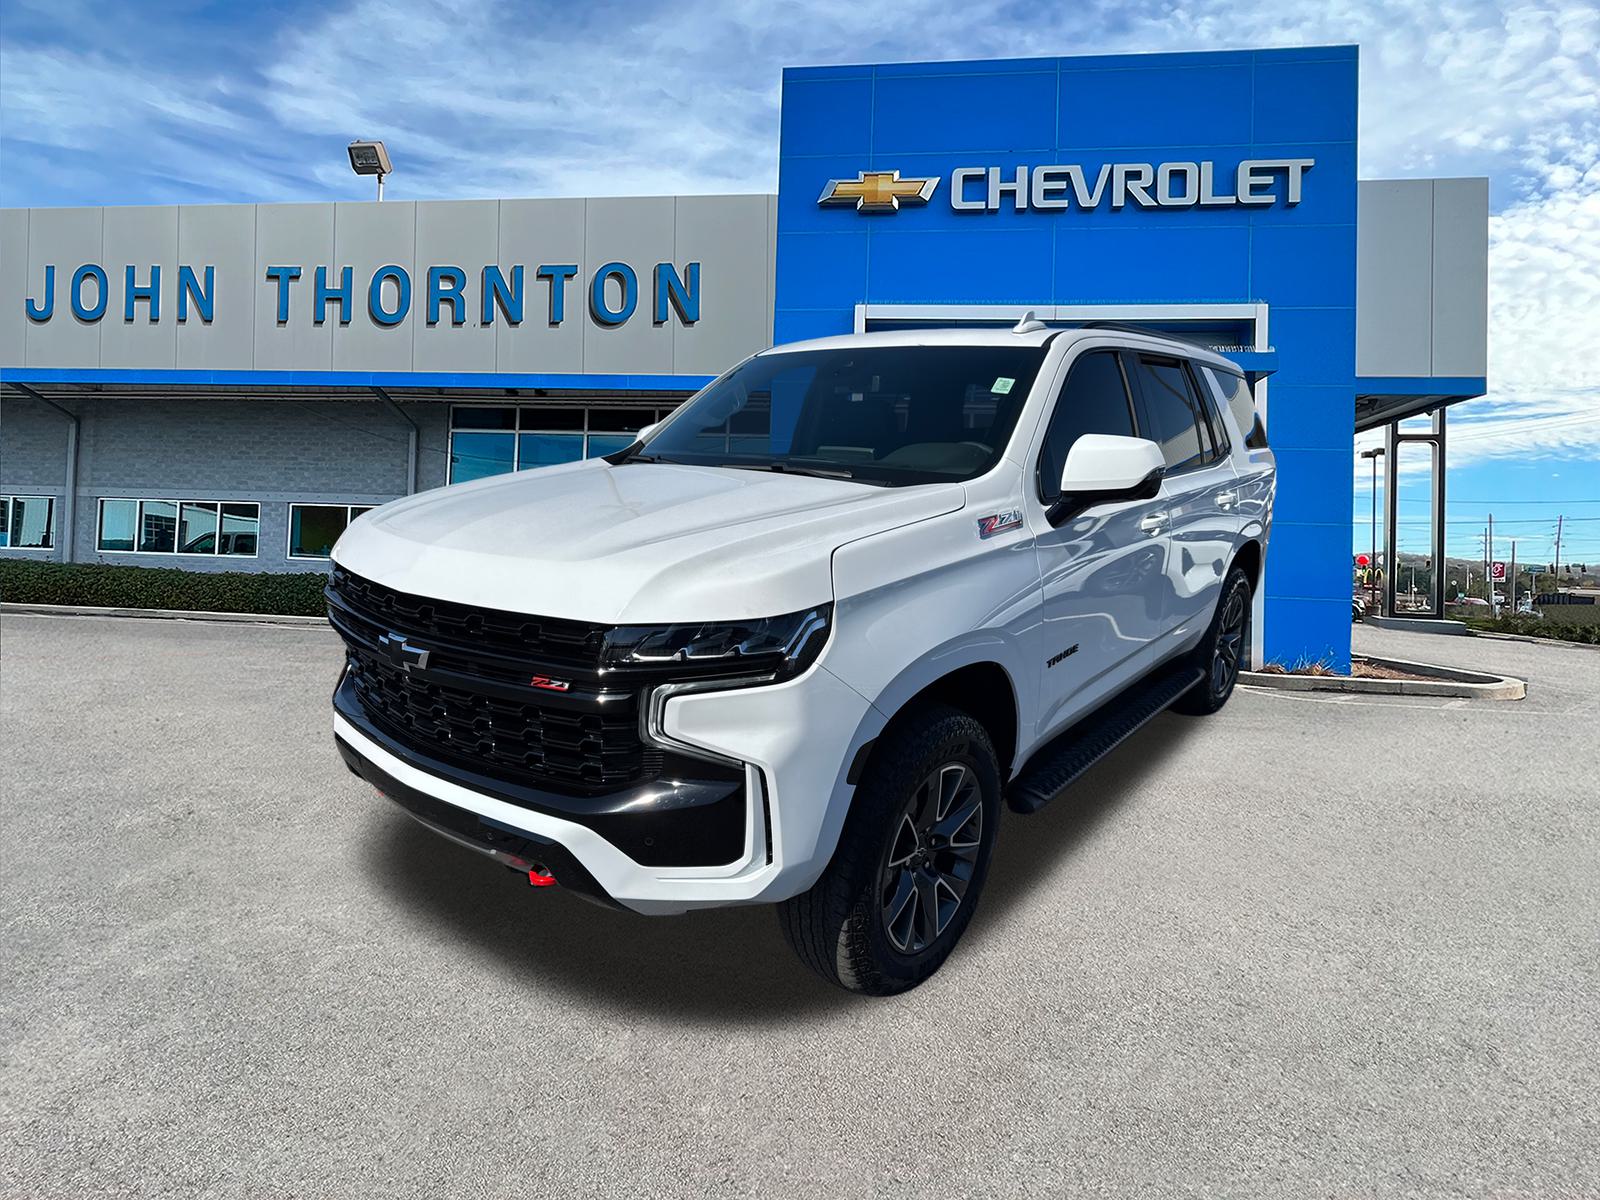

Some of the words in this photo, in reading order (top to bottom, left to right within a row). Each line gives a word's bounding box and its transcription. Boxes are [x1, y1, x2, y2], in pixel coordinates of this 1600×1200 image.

[951, 158, 1315, 210] CHEVROLET
[25, 263, 215, 323] JOHN
[265, 262, 701, 328] THORNTON
[977, 509, 1023, 540] Z71
[1046, 643, 1079, 669] TAHOE
[530, 674, 570, 691] Z71
